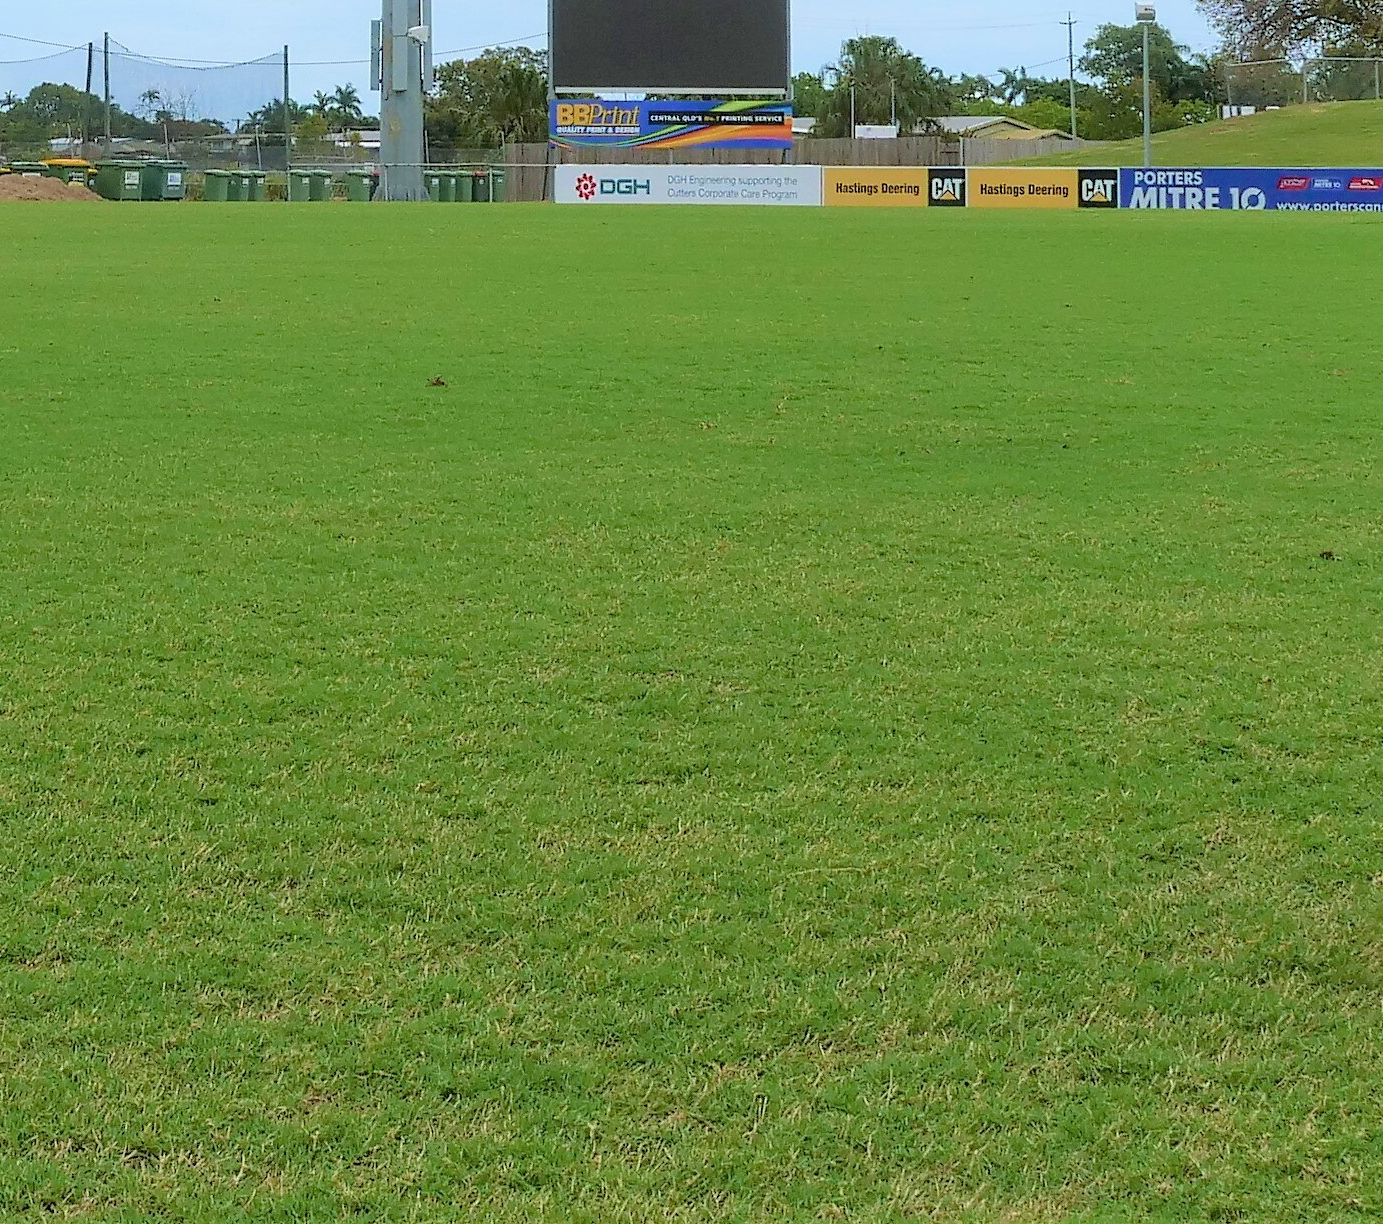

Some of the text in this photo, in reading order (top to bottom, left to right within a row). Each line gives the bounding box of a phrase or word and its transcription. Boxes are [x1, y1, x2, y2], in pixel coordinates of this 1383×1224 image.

[556, 104, 640, 125] BBPrint
[650, 114, 680, 122] CENTRAL
[721, 114, 753, 122] PRINTING
[755, 114, 783, 122] SERVICE
[668, 175, 798, 188] DGH Engineering supporting the
[1134, 171, 1203, 185] PORTERS
[600, 179, 651, 195] DGH
[836, 182, 920, 196] Hastings Deering
[931, 178, 964, 200] CAT
[980, 183, 1069, 197] Hastings Deering
[1082, 179, 1116, 202] CAT
[668, 189, 799, 200] Cutters Corporate Care Program
[1129, 187, 1266, 210] MITRE 10
